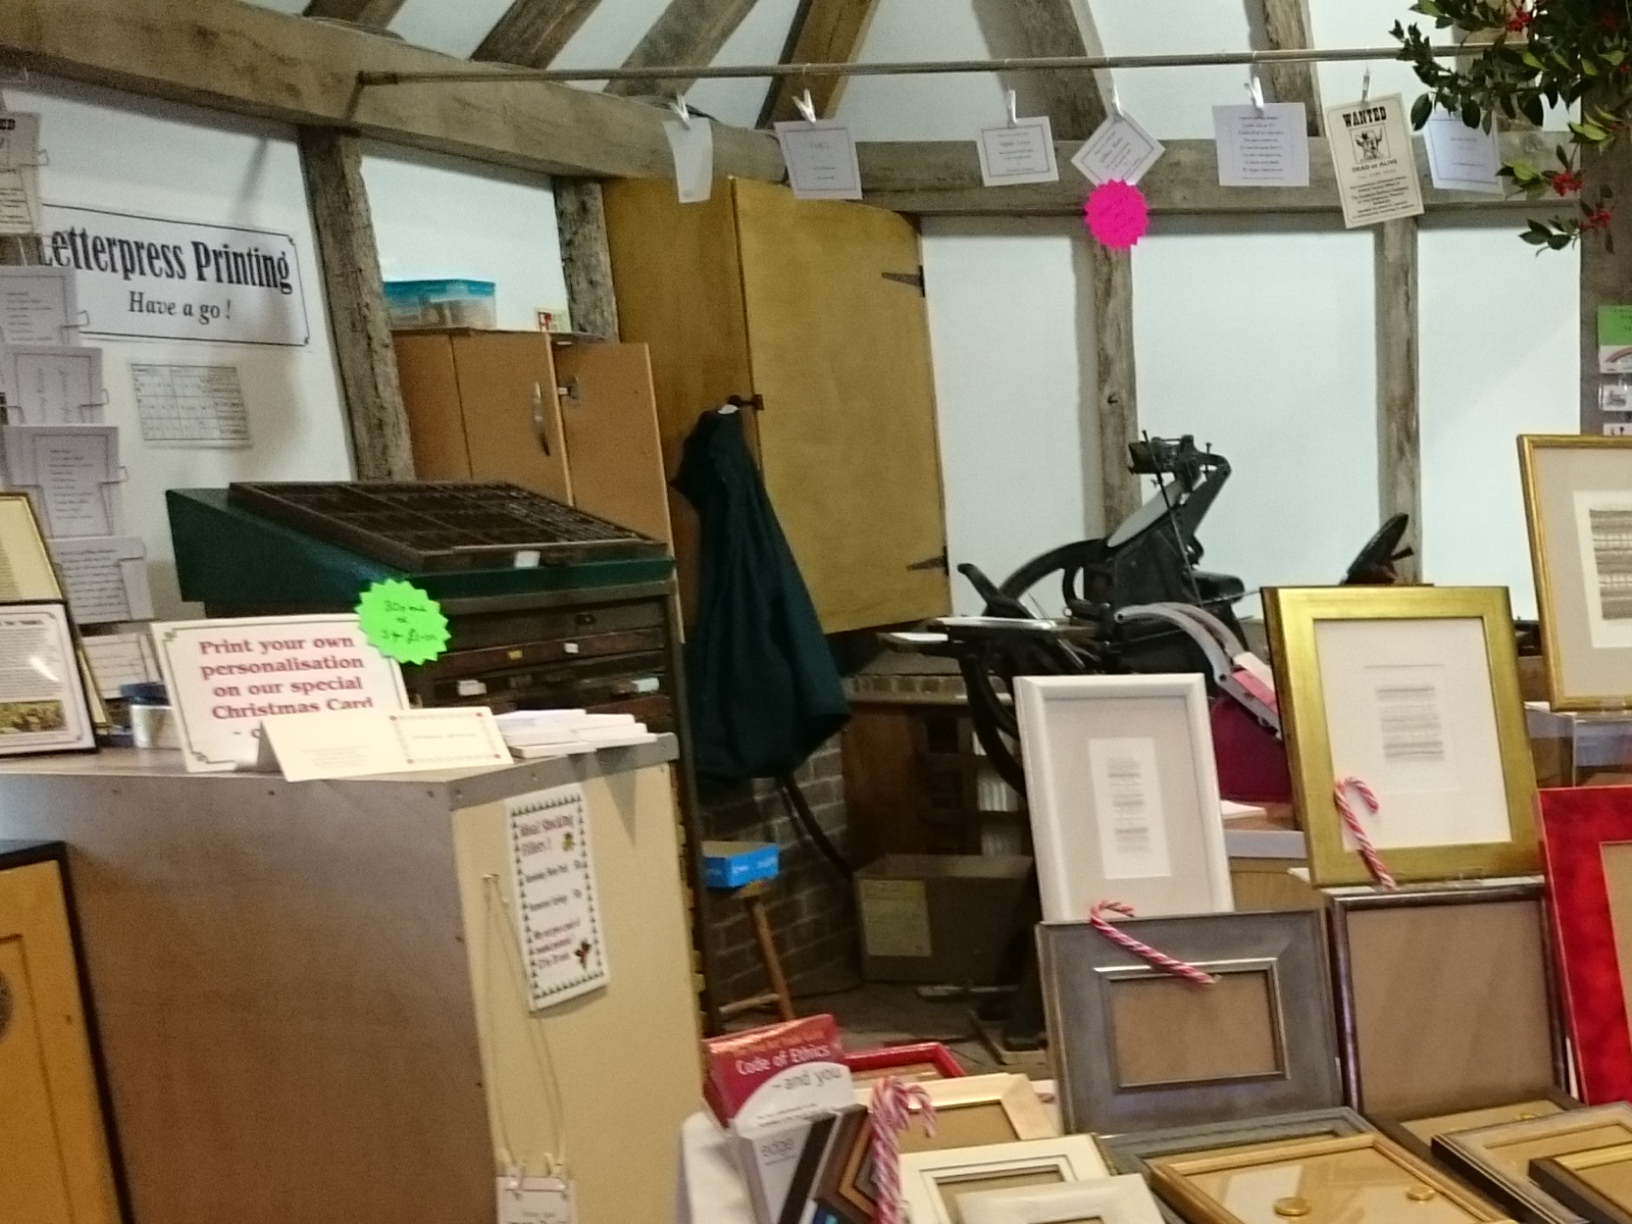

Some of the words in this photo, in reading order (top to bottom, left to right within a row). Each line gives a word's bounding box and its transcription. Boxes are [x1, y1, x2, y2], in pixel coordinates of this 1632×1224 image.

[1342, 106, 1387, 128] WANTED
[191, 239, 293, 295] Printing
[129, 291, 176, 316] Have
[183, 306, 193, 317] a
[199, 638, 252, 655] Print
[259, 636, 306, 655] your
[313, 637, 354, 649] own
[201, 655, 364, 680] personalisation
[213, 685, 240, 697] on
[250, 682, 283, 696] our
[291, 676, 363, 696] special
[211, 701, 320, 720] Christmas
[735, 1057, 771, 1075] Code
[773, 1050, 788, 1067] of
[789, 1044, 831, 1063] Ethics
[785, 1069, 811, 1090] and
[814, 1067, 842, 1087] you
